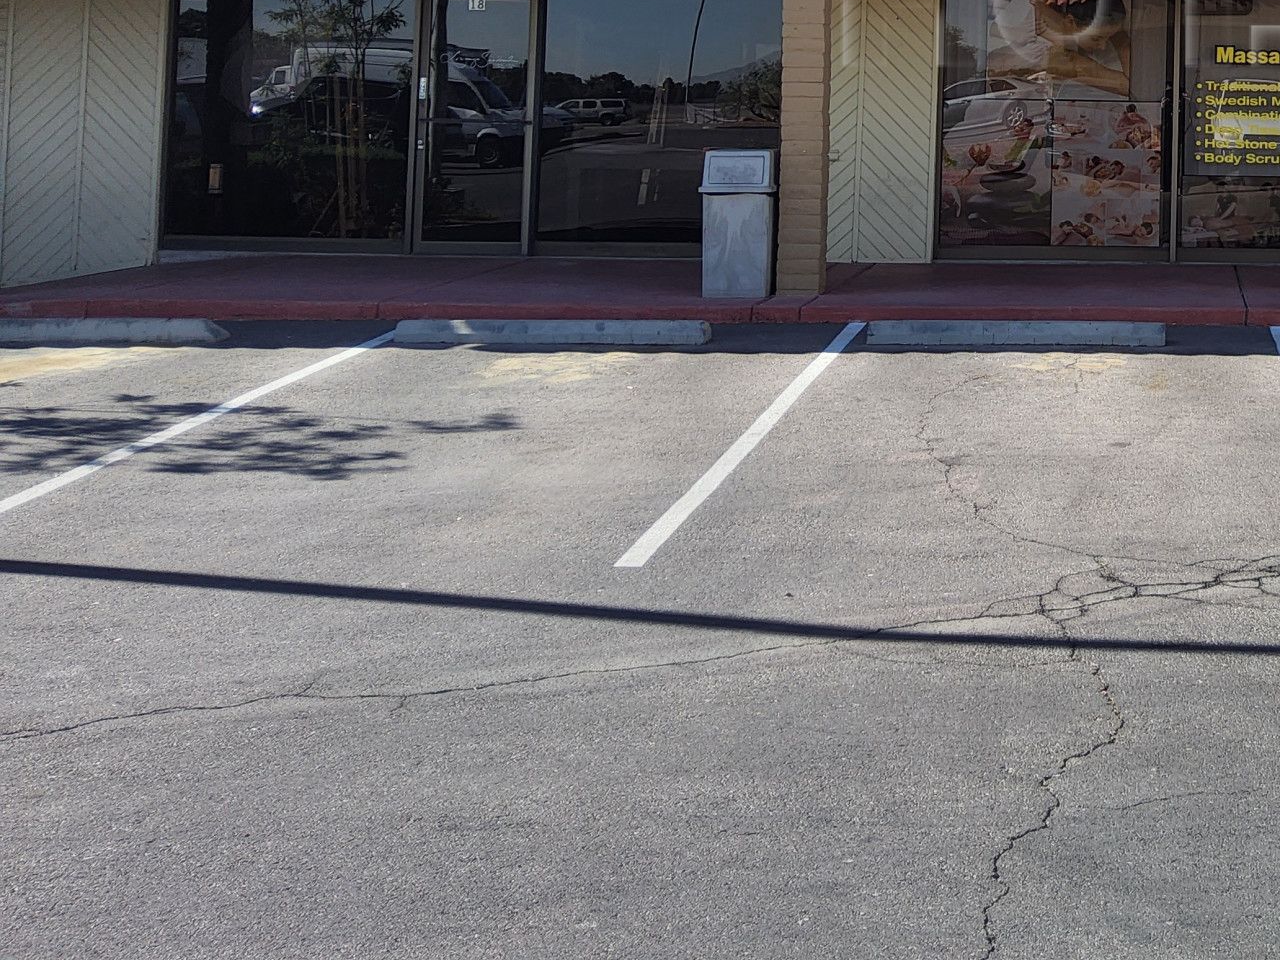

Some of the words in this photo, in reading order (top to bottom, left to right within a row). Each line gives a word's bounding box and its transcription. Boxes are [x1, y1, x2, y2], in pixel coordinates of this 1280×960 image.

[471, 0, 484, 10] 18
[1205, 81, 1280, 92] Traditional
[1205, 96, 1267, 106] Swedish
[1205, 139, 1234, 149] Hot
[1237, 140, 1277, 149] Stone
[1204, 154, 1242, 166] Body
